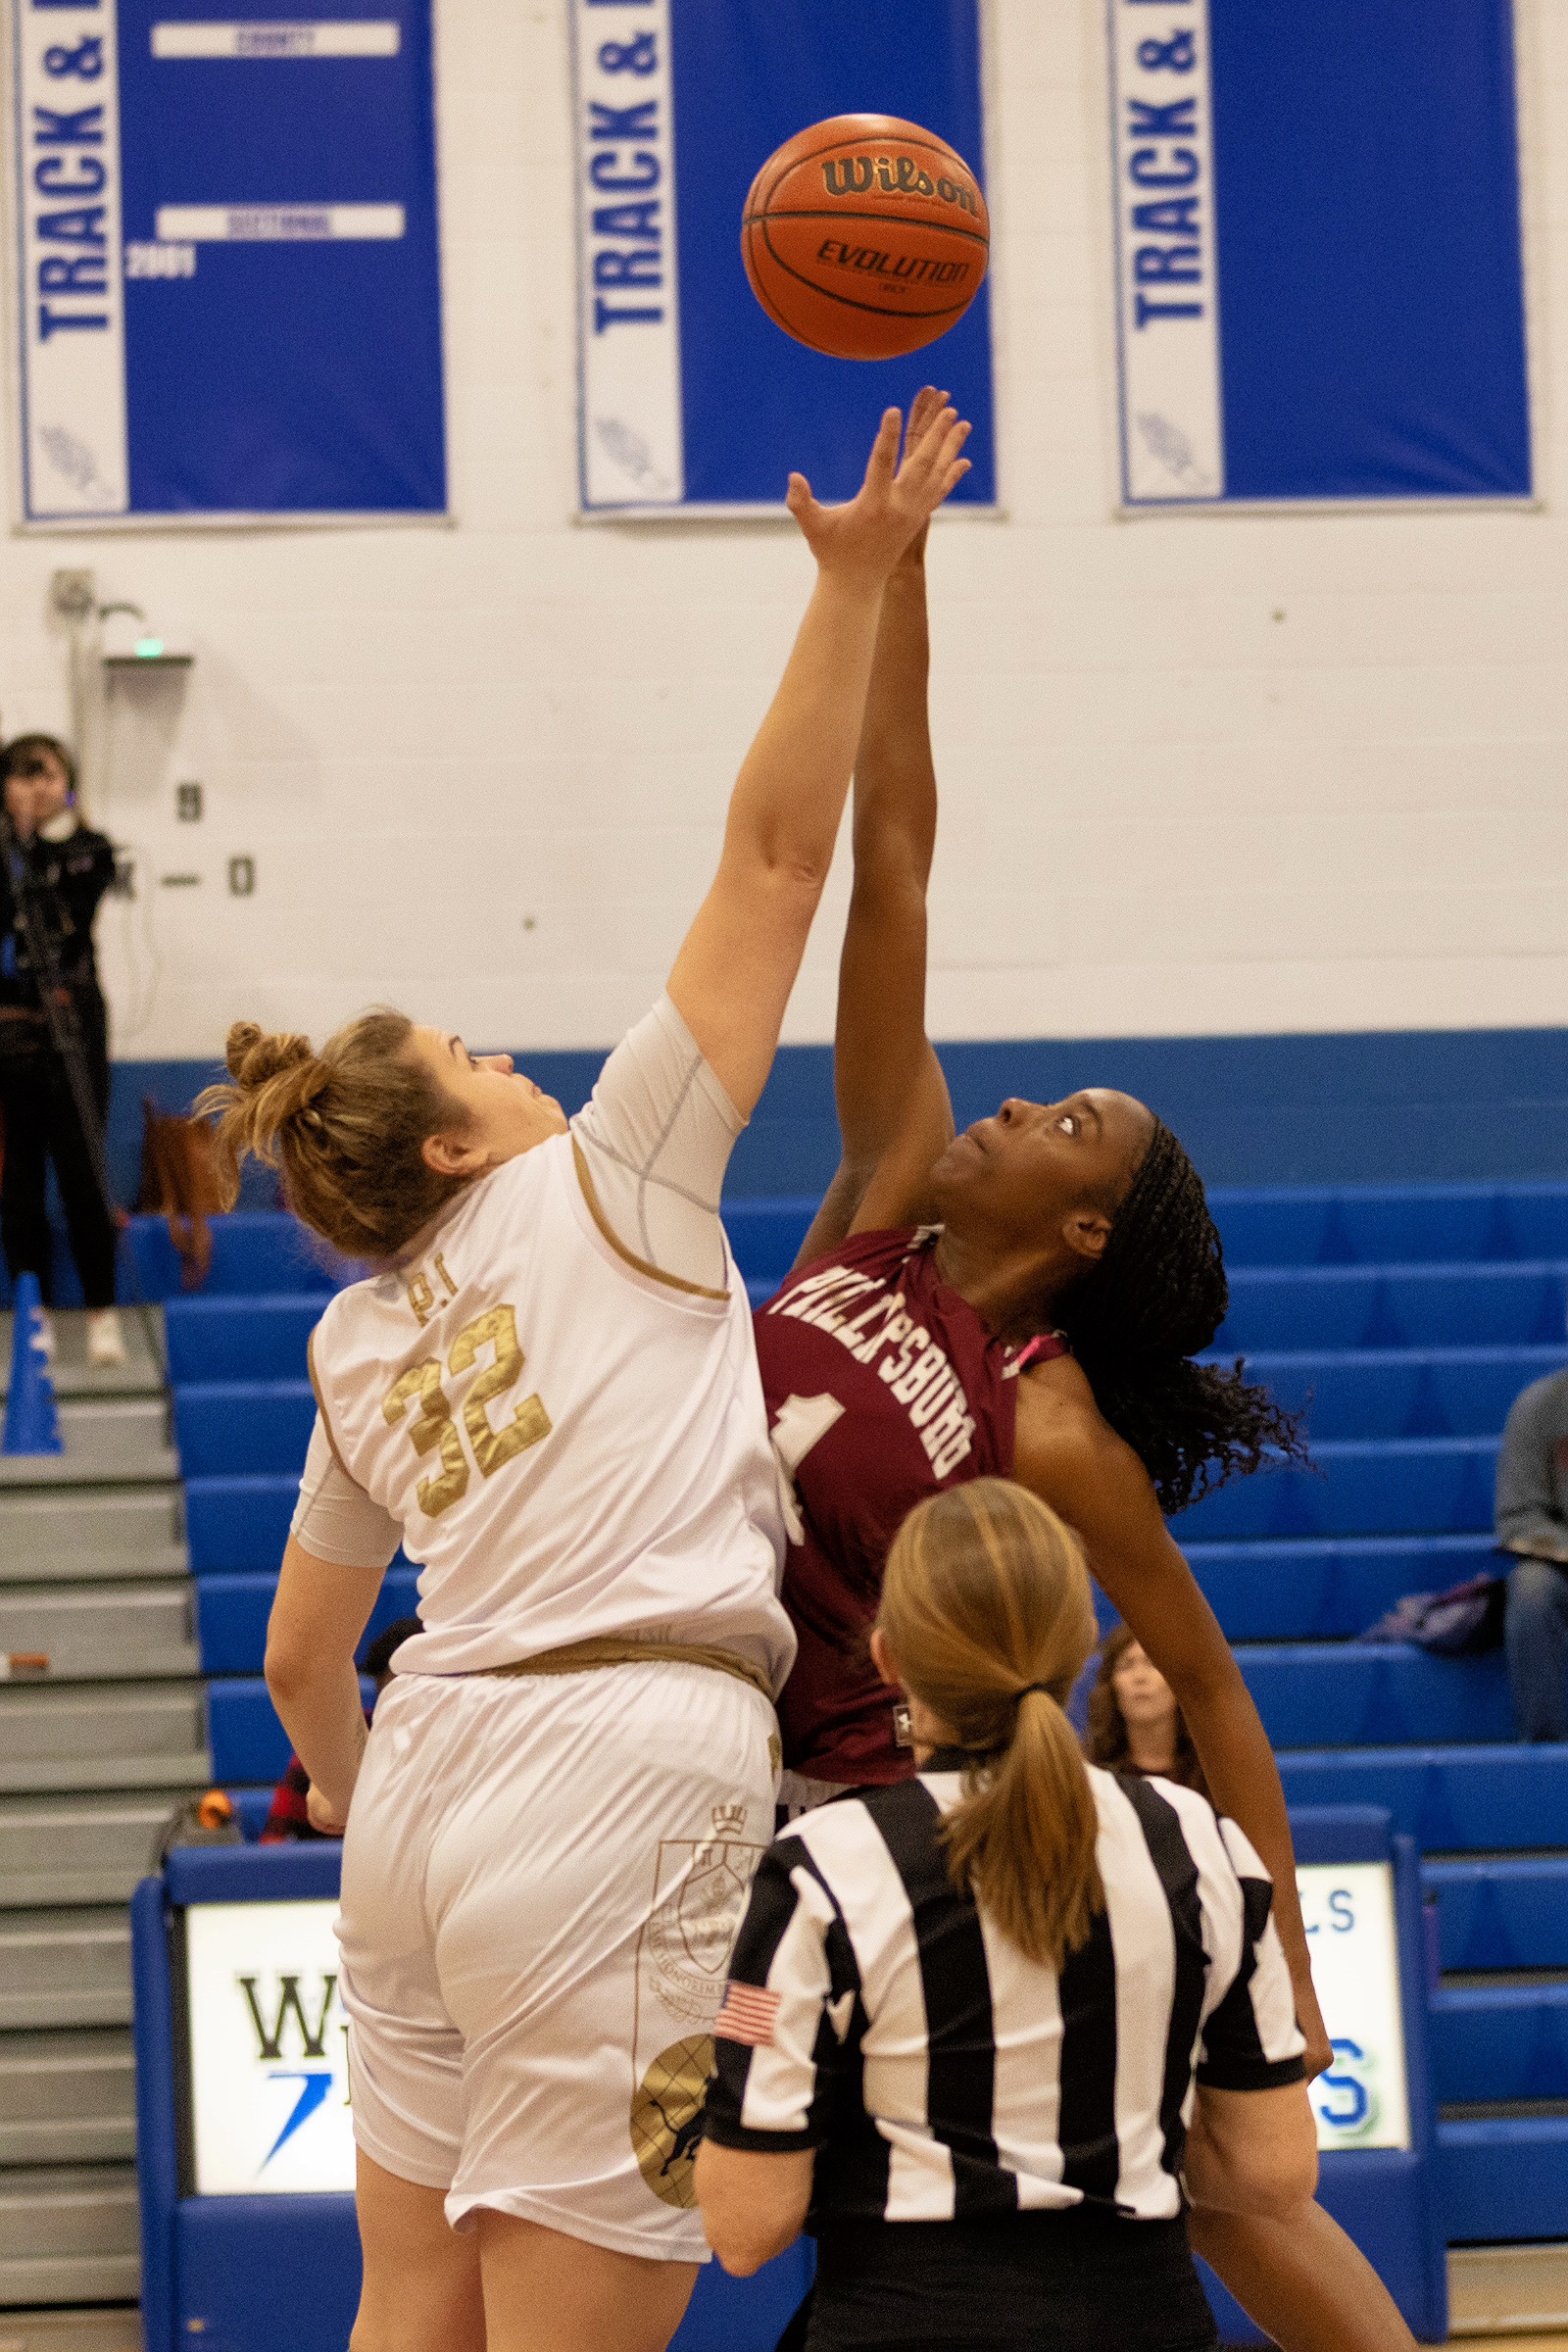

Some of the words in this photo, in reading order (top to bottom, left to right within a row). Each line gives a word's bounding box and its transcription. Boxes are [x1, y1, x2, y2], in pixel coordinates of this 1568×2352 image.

[44, 36, 104, 79] &
[598, 30, 658, 77] &
[1137, 27, 1196, 74] &
[590, 100, 663, 335] TRACK
[821, 156, 978, 218] Wilson
[1129, 97, 1203, 330] TRACK
[34, 104, 109, 341] TRACK
[816, 239, 970, 283] EVOLUTION
[383, 1303, 553, 1518] 32
